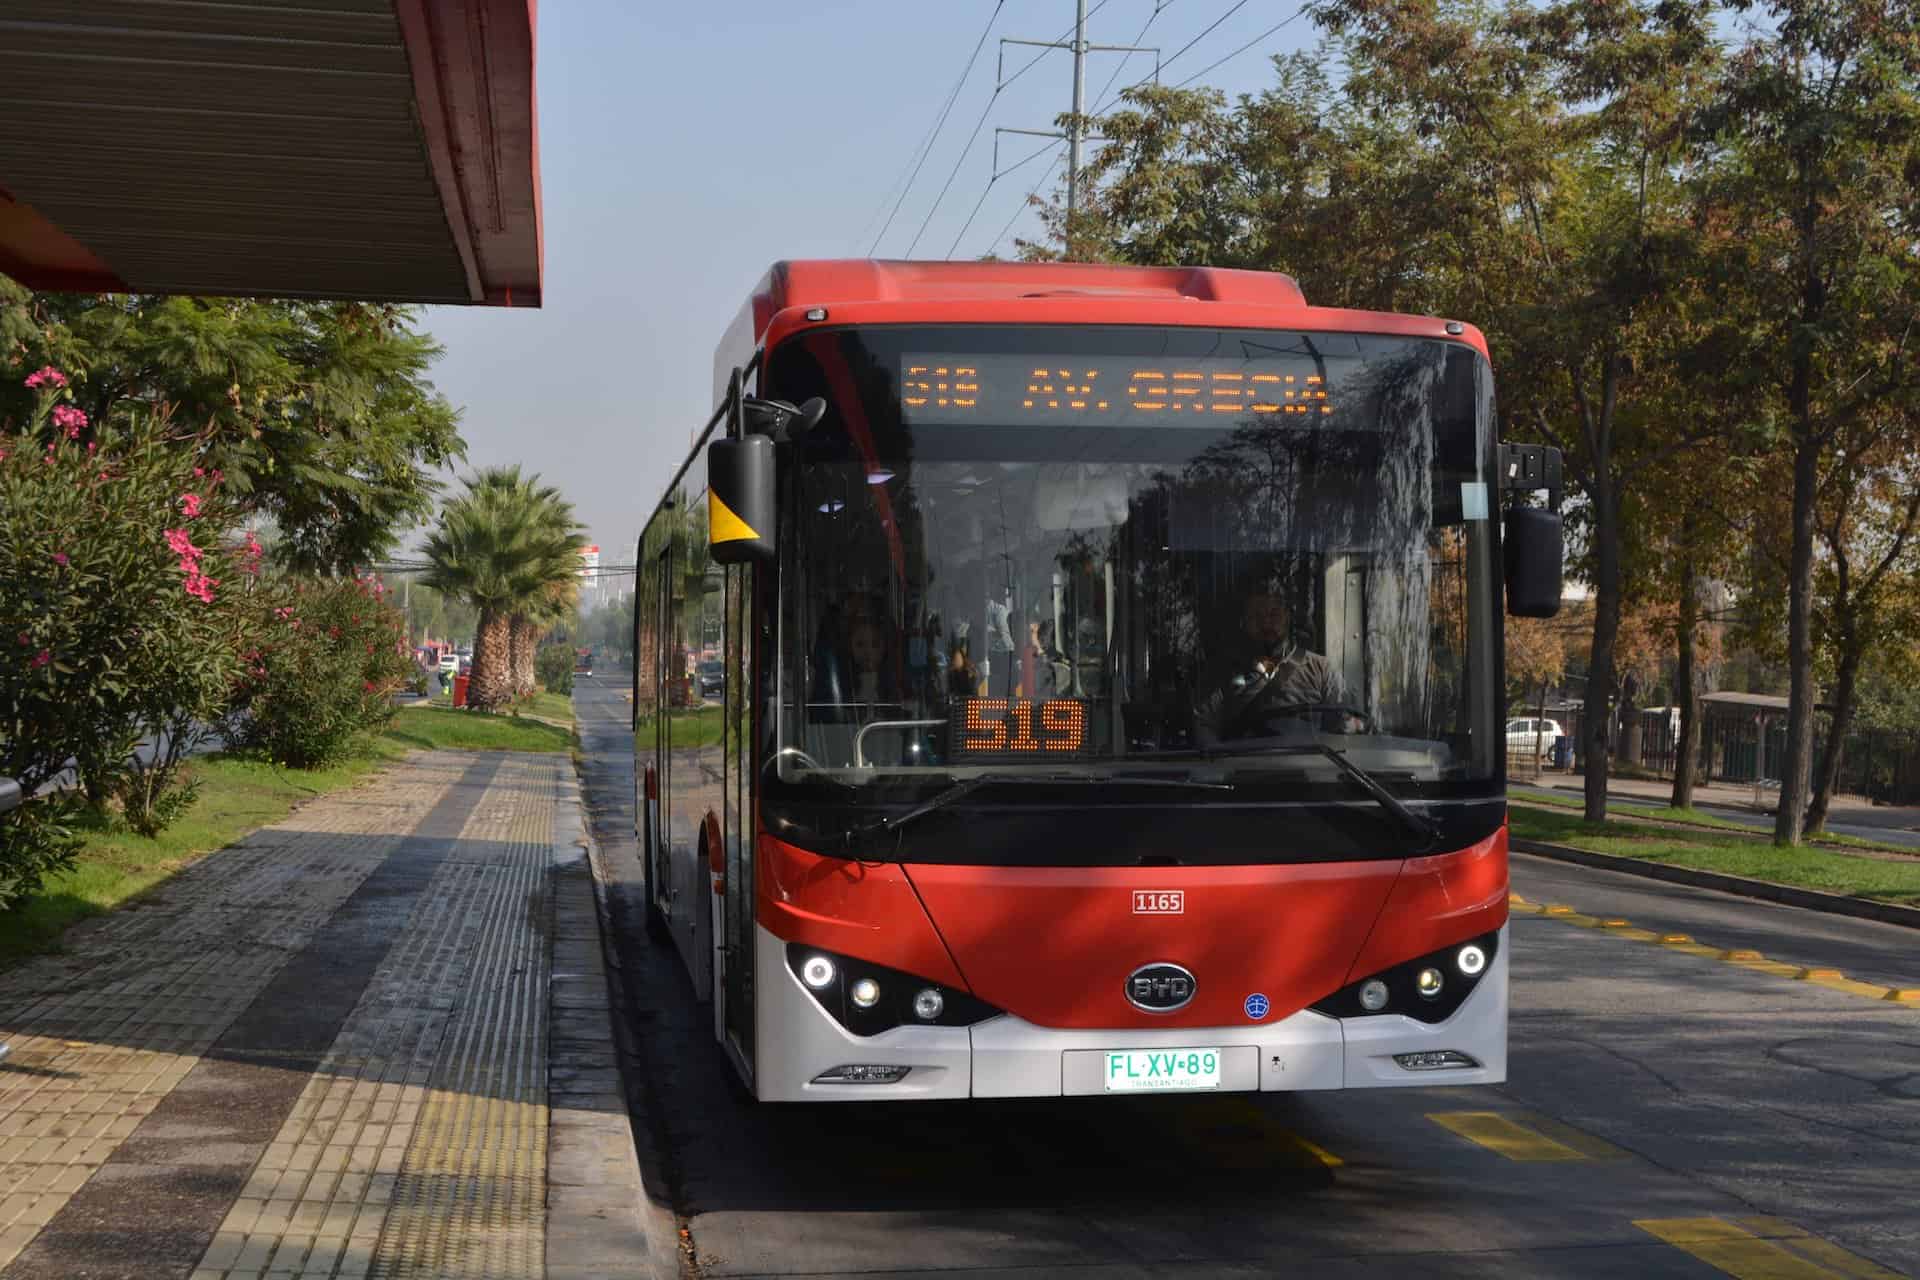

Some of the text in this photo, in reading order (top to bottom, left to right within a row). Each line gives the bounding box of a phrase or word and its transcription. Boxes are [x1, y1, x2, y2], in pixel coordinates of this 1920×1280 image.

[1023, 368, 1108, 409] AV.
[1129, 371, 1333, 414] GRECIA
[966, 699, 1083, 751] 519
[1136, 894, 1180, 911] 1165
[1133, 977, 1188, 998] BYD
